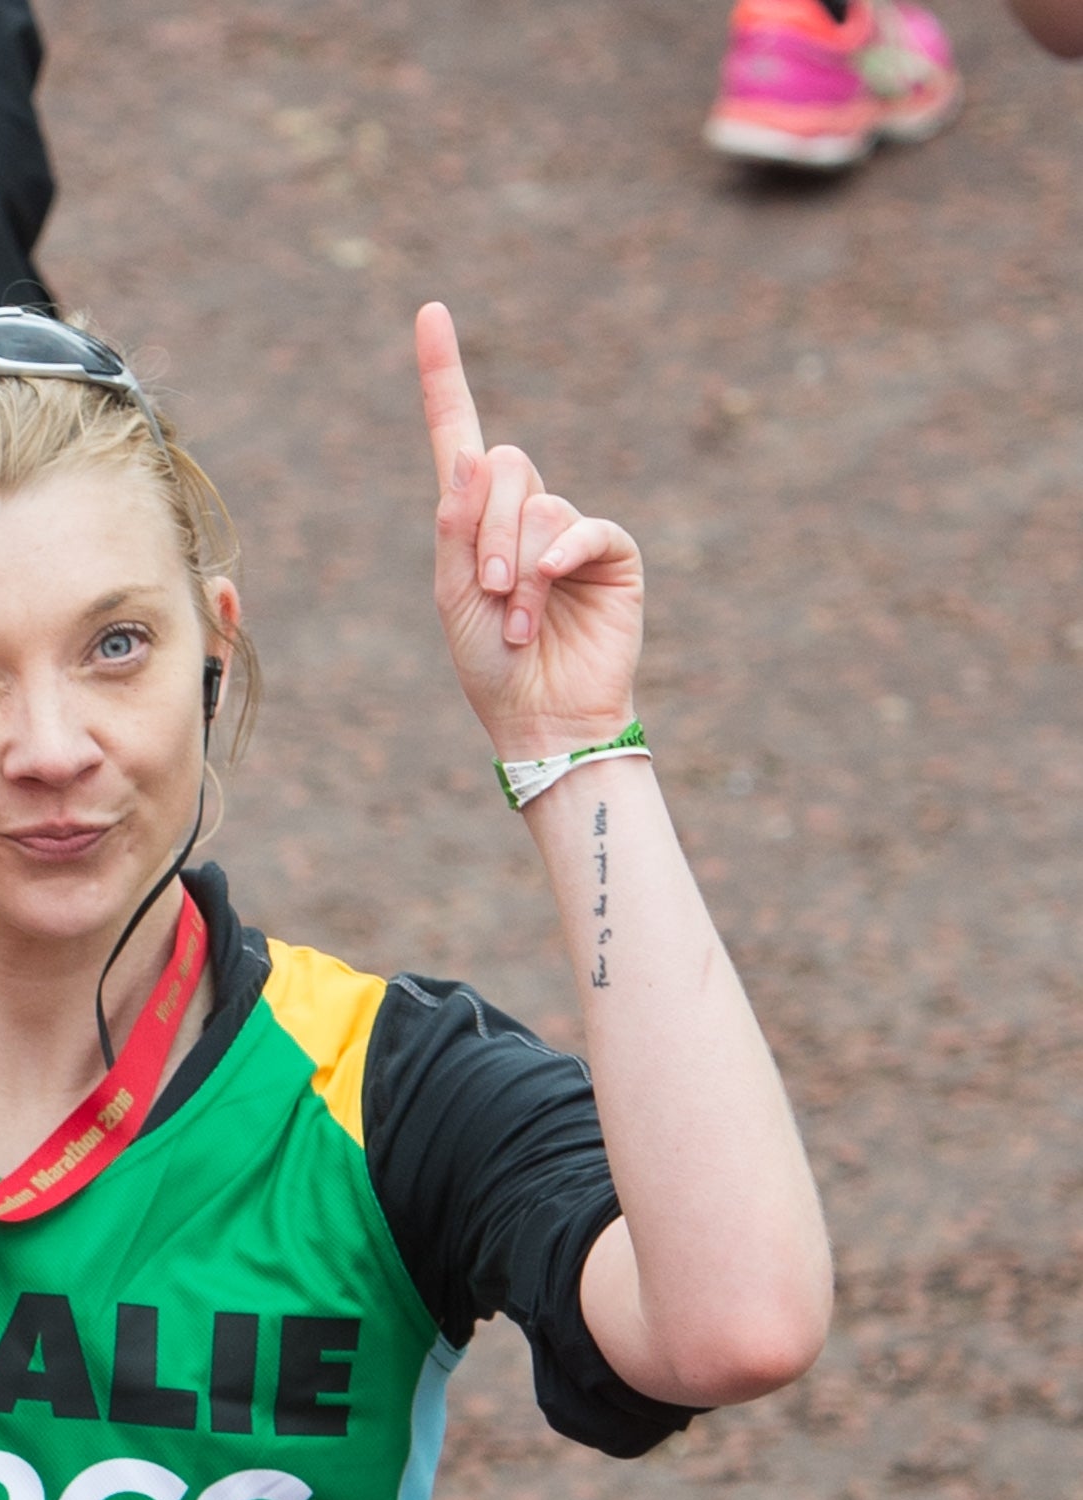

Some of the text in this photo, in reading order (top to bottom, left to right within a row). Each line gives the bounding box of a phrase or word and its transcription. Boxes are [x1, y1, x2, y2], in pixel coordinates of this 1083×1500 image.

[593, 893, 608, 918] the
[591, 955, 611, 989] Fear
[30, 1126, 105, 1192] Marathon
[97, 1087, 135, 1131] 2016
